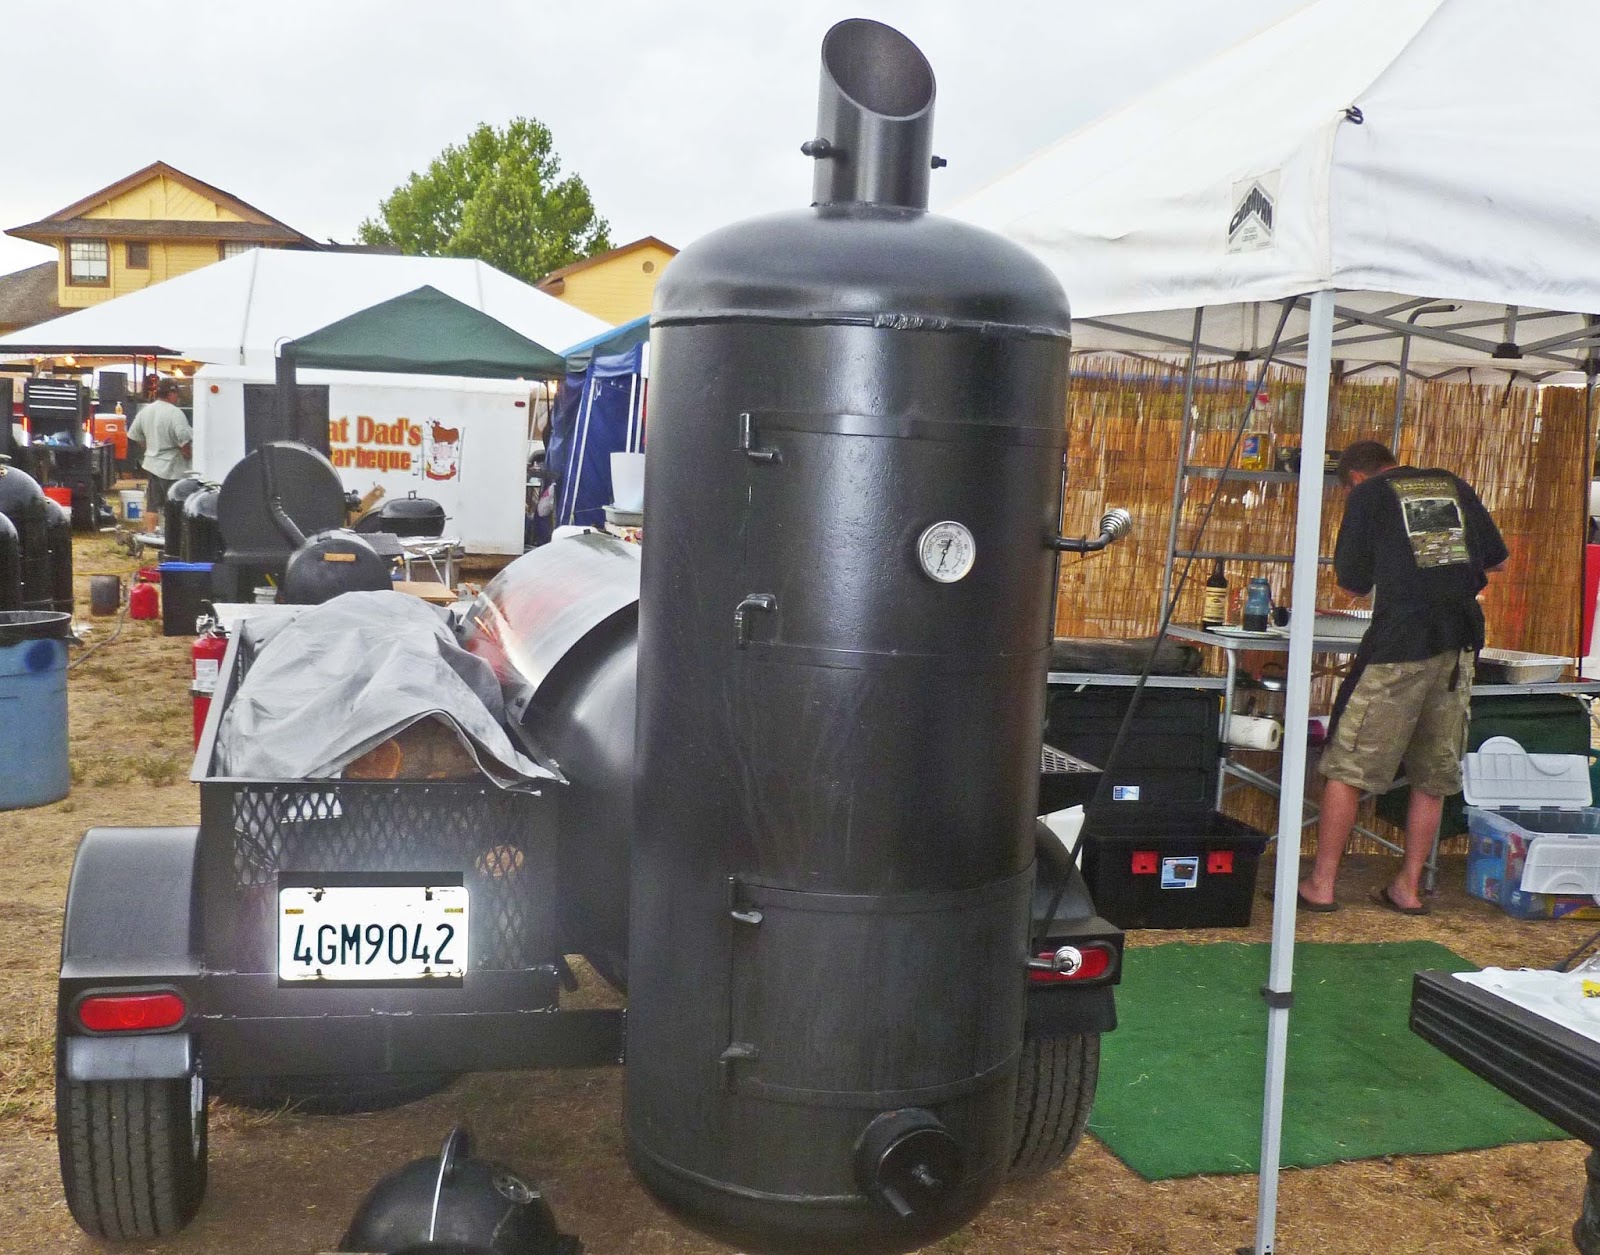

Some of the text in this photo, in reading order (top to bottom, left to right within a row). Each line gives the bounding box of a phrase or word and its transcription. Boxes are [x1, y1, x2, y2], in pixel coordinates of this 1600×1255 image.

[357, 415, 421, 446] Dad's
[330, 446, 411, 472] arbeque
[293, 923, 454, 965] 4GM9042
